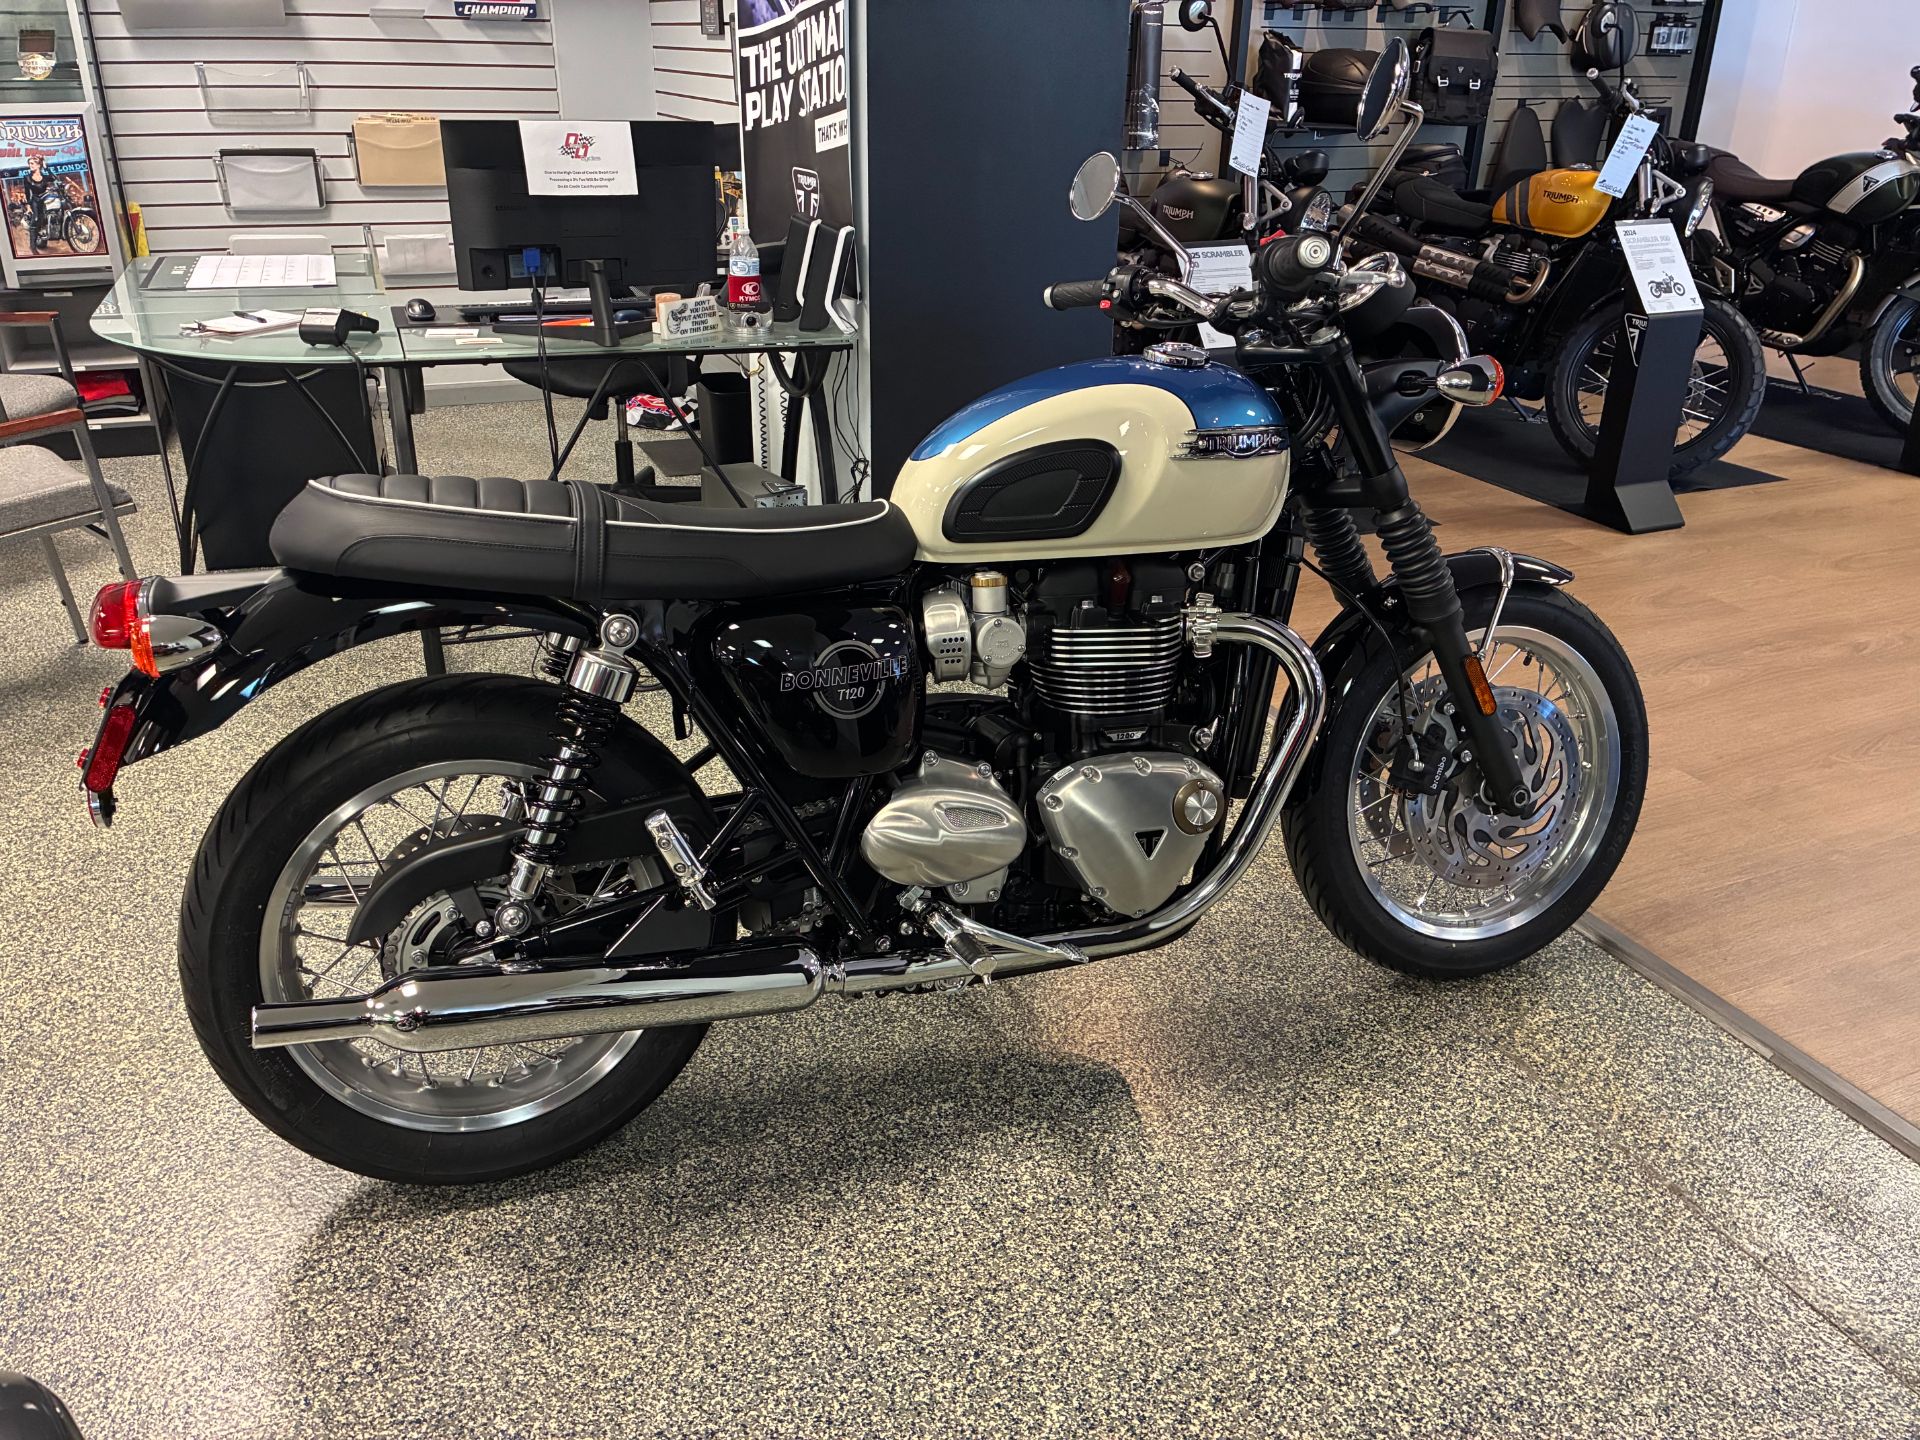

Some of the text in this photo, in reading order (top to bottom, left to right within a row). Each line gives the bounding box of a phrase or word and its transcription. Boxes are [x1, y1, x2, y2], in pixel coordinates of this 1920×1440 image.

[463, 4, 529, 16] CHAMPION
[740, 35, 782, 88] THE
[744, 54, 847, 131] PLAY STATIO
[817, 122, 838, 144] THAT'S
[1544, 190, 1580, 204] TRIUMPH
[1162, 204, 1195, 220] TRIUMPH
[1201, 249, 1245, 259] SCRAMBLER
[689, 304, 716, 314] YOU DARE
[694, 299, 711, 307] DON'T
[691, 318, 709, 327] THING
[692, 311, 717, 320] ANOTHER
[689, 326, 701, 334] THIS
[1631, 318, 1648, 328] TRIU
[1205, 433, 1272, 456] TRIUMPH
[780, 655, 908, 692] BONNEVILLE
[837, 686, 865, 701] T120
[1430, 756, 1447, 789] brembo
